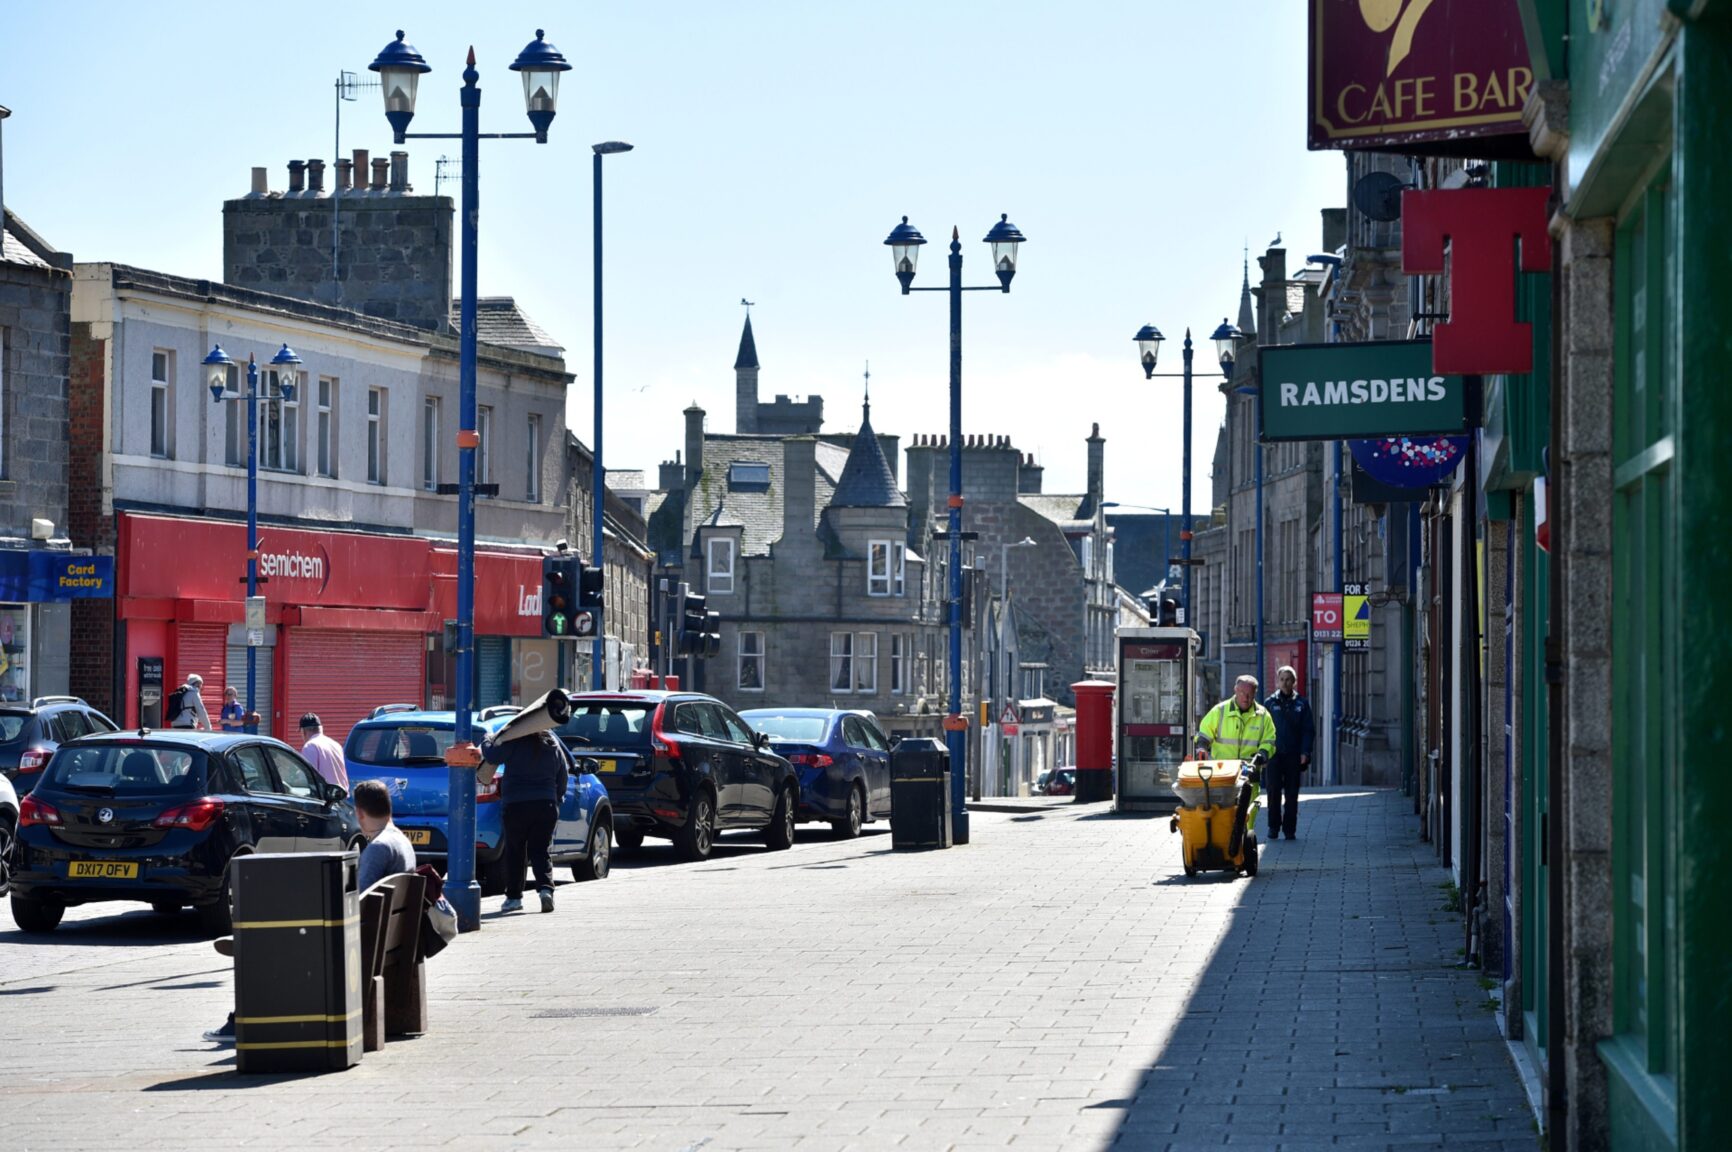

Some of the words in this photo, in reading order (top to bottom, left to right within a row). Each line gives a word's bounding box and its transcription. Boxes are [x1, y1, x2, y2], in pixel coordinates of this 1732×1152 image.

[1337, 76, 1435, 123] CAFE
[1454, 67, 1533, 112] BAR
[1280, 376, 1446, 407] RAMSDENS
[67, 564, 95, 575] Card
[261, 549, 322, 579] semichem
[59, 576, 102, 589] Factory
[1344, 585, 1361, 594] FOR
[1314, 610, 1336, 624] TO
[77, 863, 103, 875] DX17
[106, 864, 130, 876] OFV
